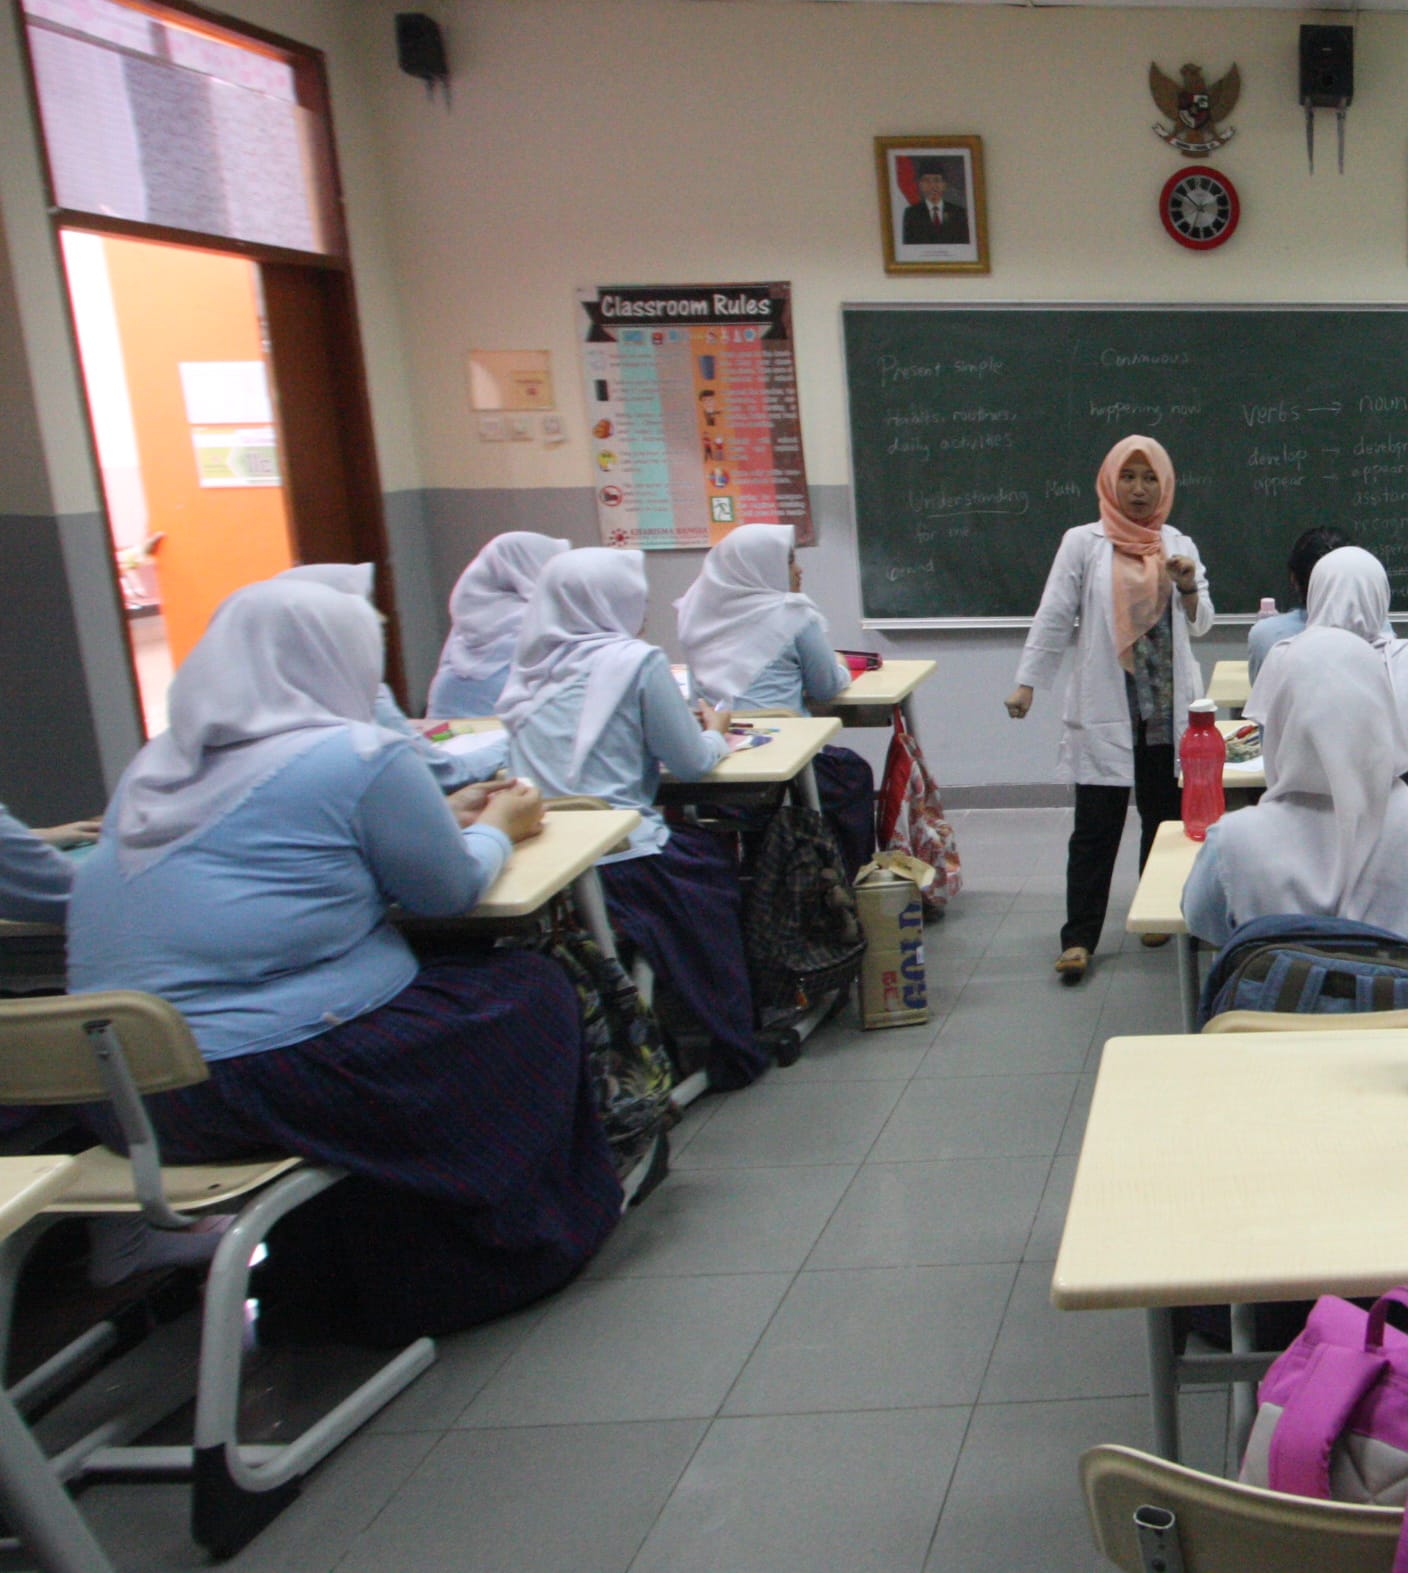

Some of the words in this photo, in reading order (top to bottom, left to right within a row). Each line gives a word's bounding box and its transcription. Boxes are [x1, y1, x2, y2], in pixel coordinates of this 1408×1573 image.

[601, 294, 708, 317] Classroom
[712, 293, 771, 315] Rules
[879, 354, 941, 387] Present
[1248, 443, 1308, 473] develop
